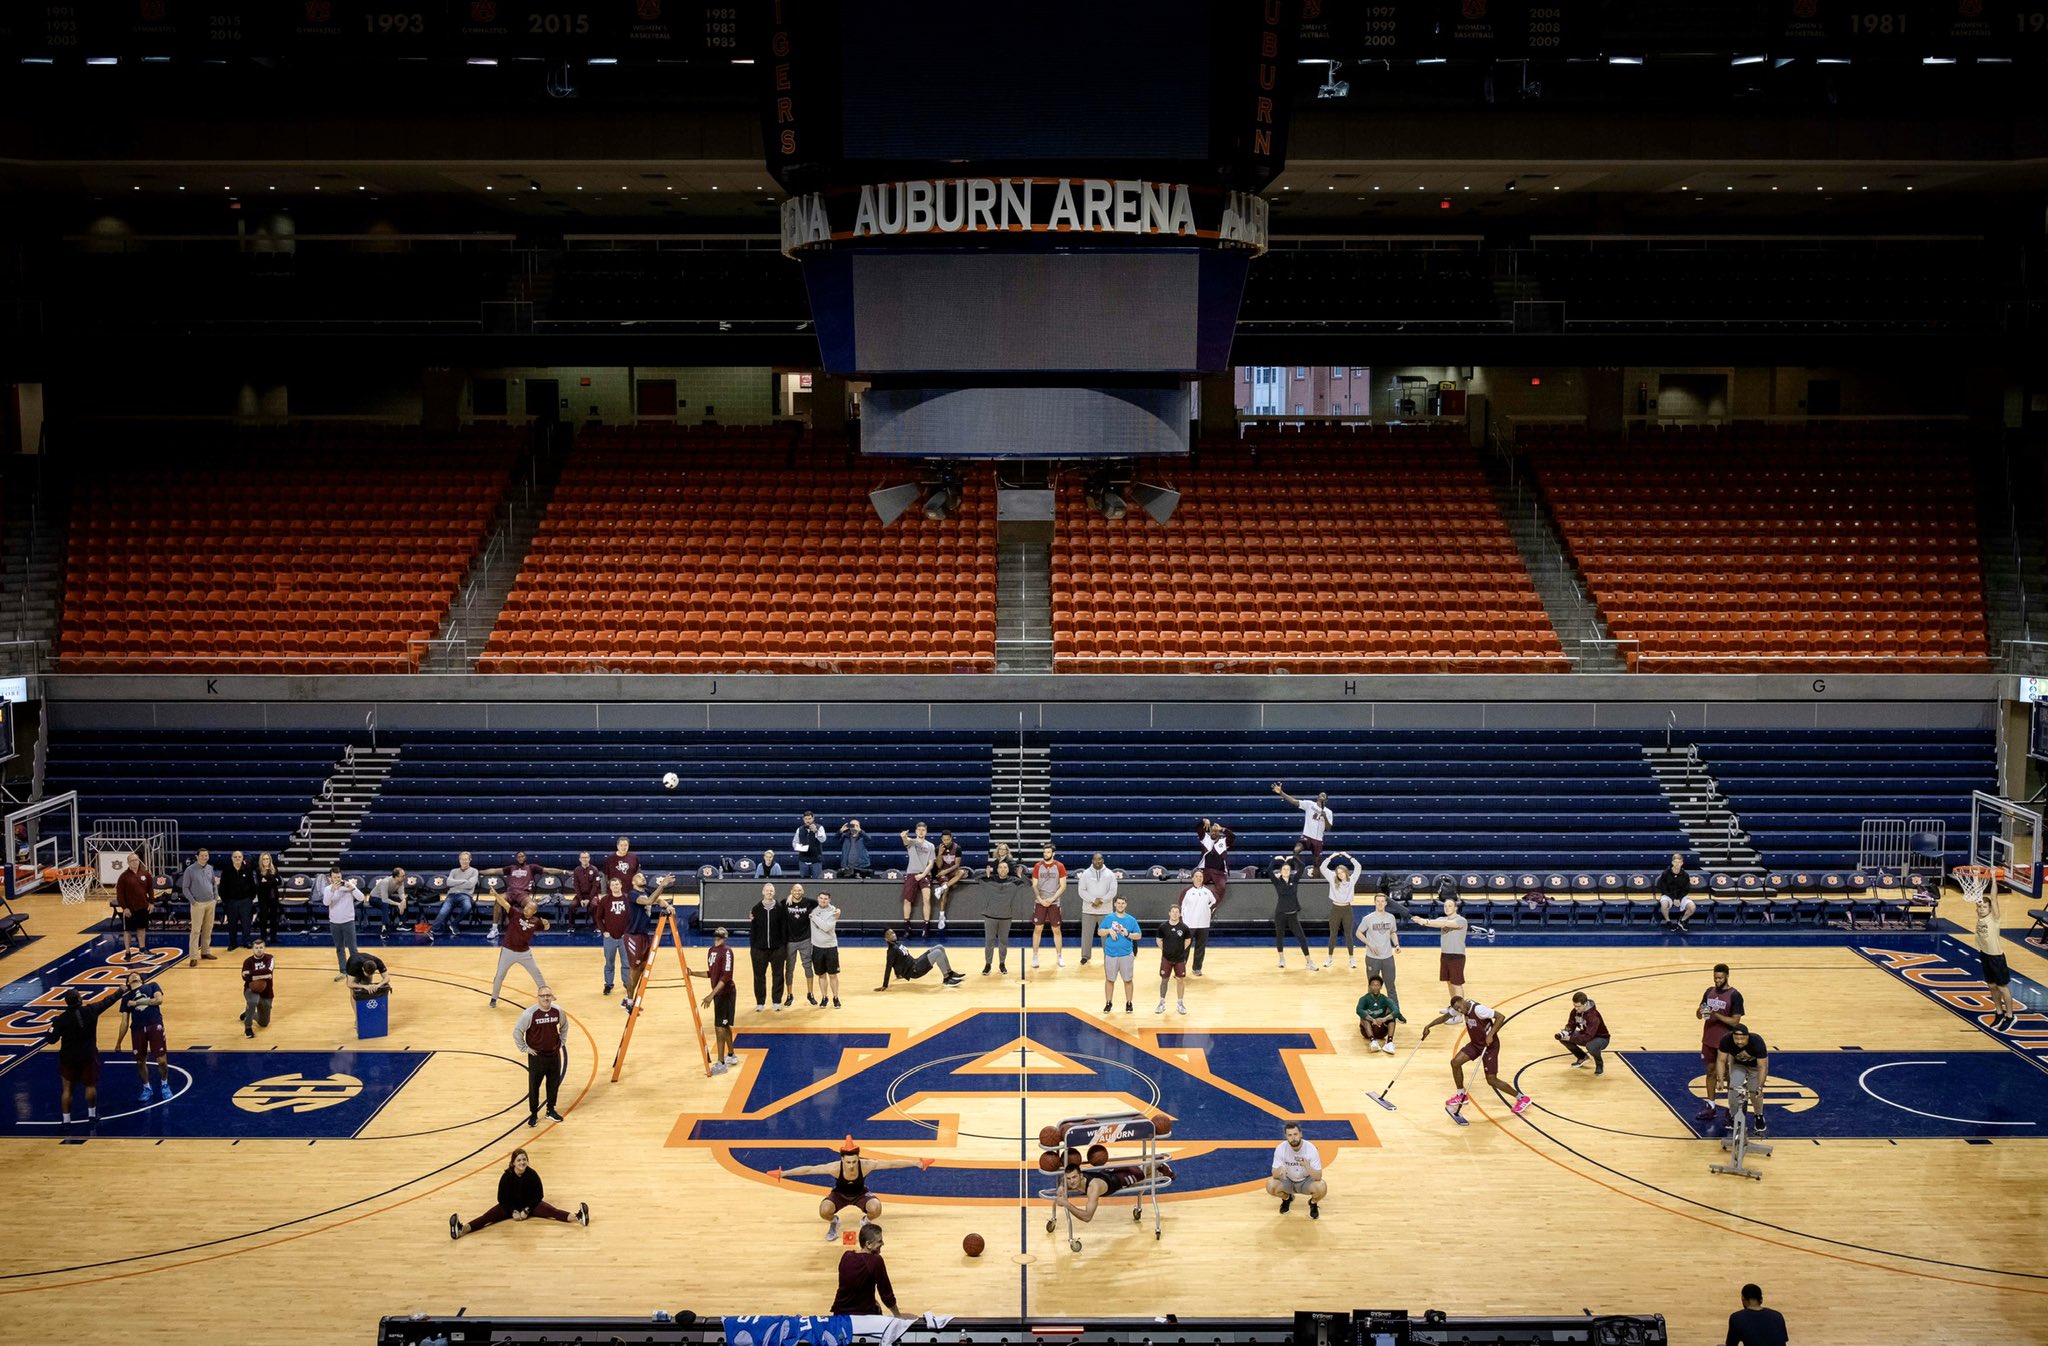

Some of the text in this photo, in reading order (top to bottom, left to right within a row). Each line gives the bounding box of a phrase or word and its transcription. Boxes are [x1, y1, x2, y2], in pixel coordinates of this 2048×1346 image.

[706, 9, 736, 19] 1982
[1366, 7, 1396, 17] 1997
[1528, 8, 1560, 18] 2004
[210, 16, 241, 26] 2015
[365, 14, 424, 33] 1993
[528, 14, 590, 33] 2015
[1366, 21, 1396, 31] 1999
[1850, 14, 1906, 33] 1981
[706, 23, 736, 33] 1983
[1528, 23, 1560, 33] 2008
[210, 30, 242, 40] 2016
[706, 37, 736, 47] 1985
[1364, 36, 1396, 46] 2000
[1528, 37, 1560, 47] 2009
[853, 178, 1197, 237] AUBURN ARENA
[207, 680, 218, 694] K
[710, 681, 717, 695] J
[1344, 680, 1356, 695] H
[1812, 680, 1826, 693] G
[0, 947, 184, 1064] IGERS
